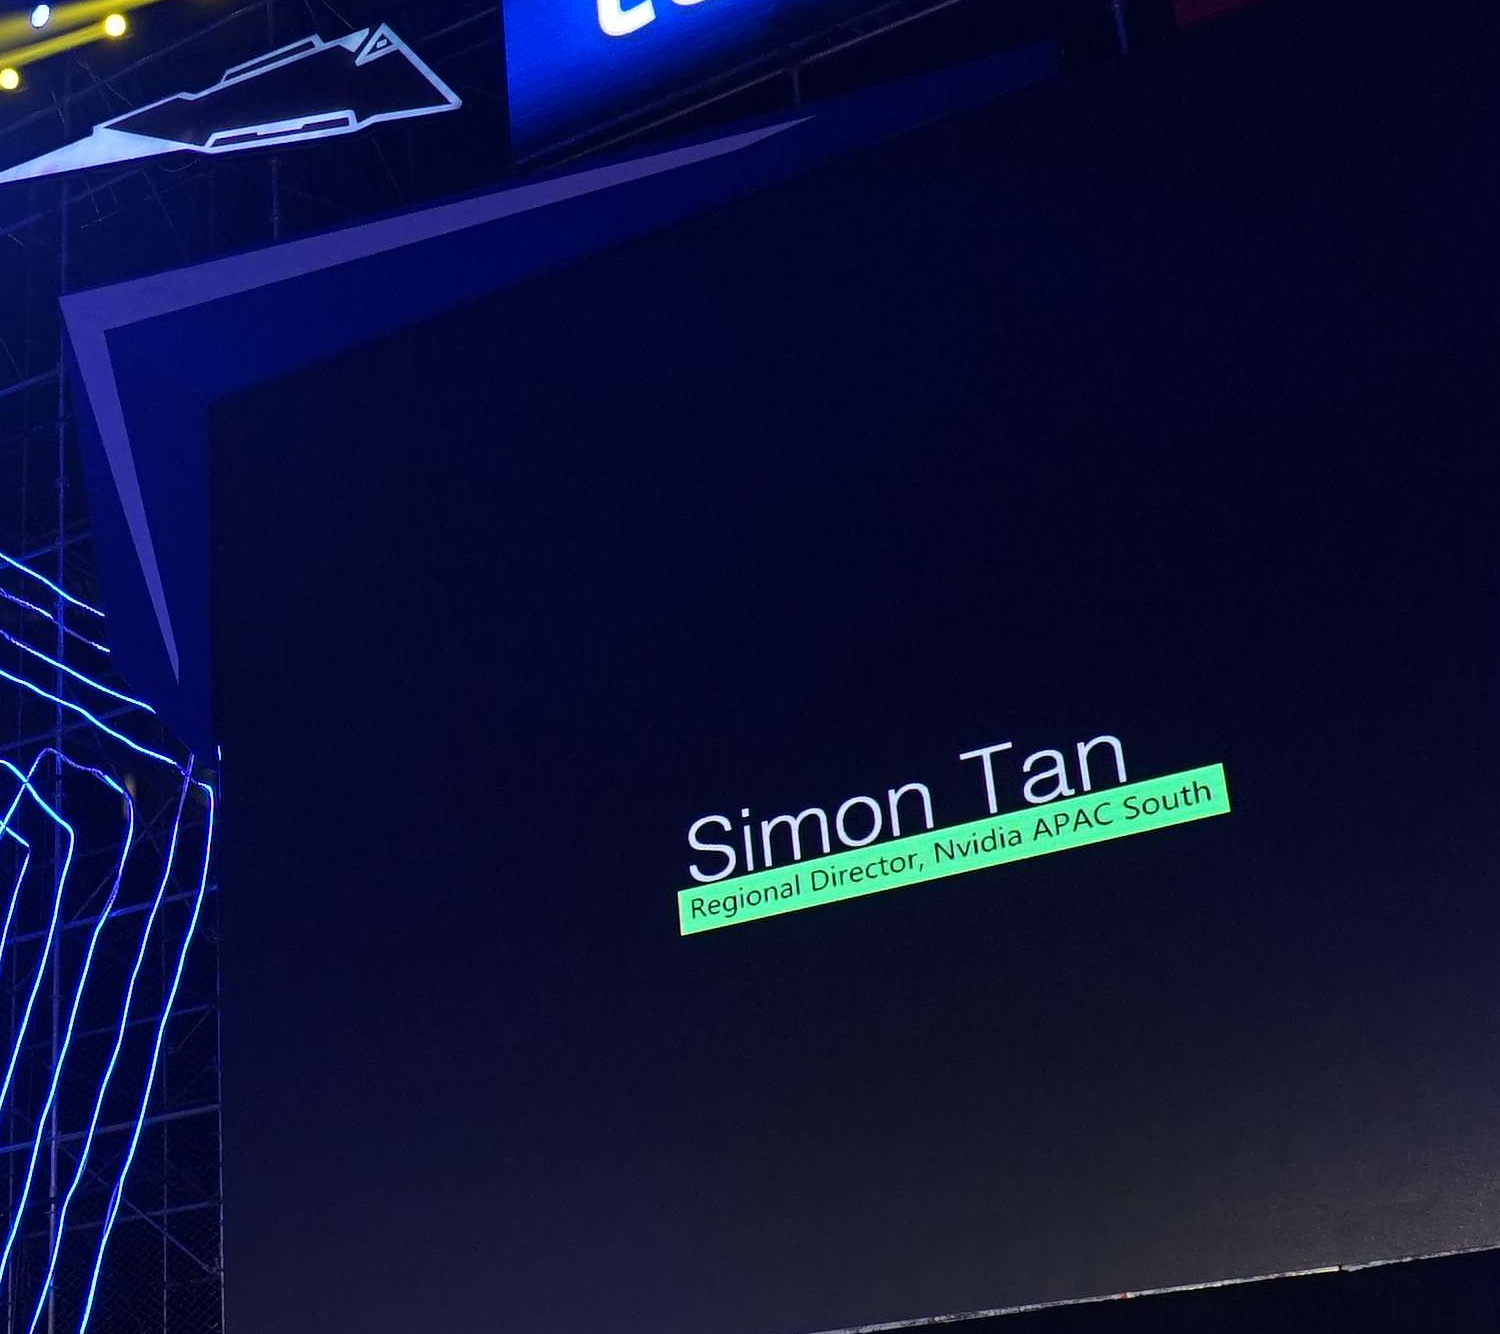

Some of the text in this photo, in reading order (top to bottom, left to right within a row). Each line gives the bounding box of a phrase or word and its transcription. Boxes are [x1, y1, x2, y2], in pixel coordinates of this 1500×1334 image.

[686, 734, 1129, 883] Simon Tan
[689, 779, 1213, 921] Regional Director, Nvidia APAC South
